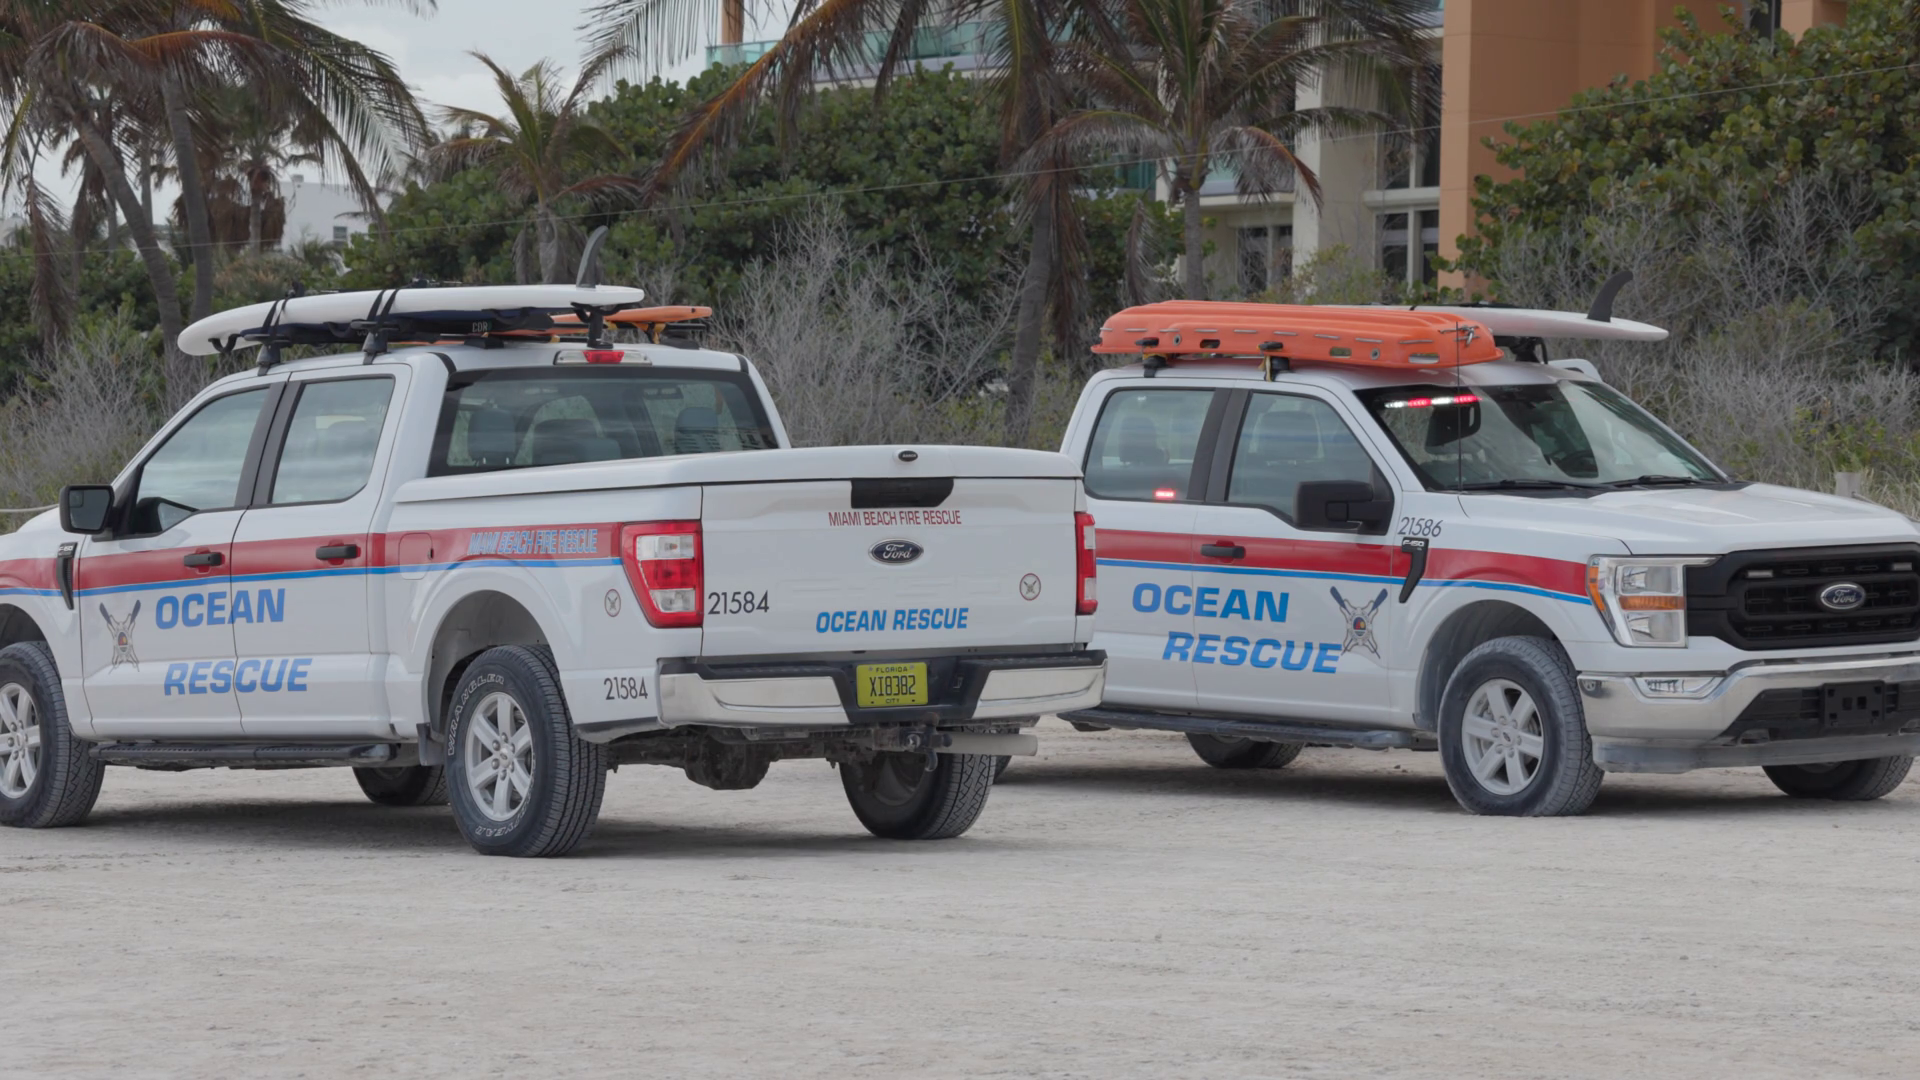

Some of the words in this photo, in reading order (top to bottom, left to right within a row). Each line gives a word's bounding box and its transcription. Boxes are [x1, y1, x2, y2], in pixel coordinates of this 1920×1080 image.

[828, 512, 861, 526] MIAMI
[863, 511, 897, 526] BEACH
[899, 511, 921, 525] FIRE
[923, 510, 962, 525] RESCUE
[1397, 516, 1444, 537] 21586
[497, 530, 534, 554] BEACH
[533, 529, 558, 554] FIRE
[559, 528, 598, 554] RESCUE
[155, 588, 286, 630] OCEAN
[708, 590, 769, 614] 21584
[1132, 583, 1289, 623] OCEAN
[816, 610, 887, 633] OCEAN
[893, 608, 969, 631] RESCUE
[1162, 631, 1342, 674] RESCUE
[164, 658, 313, 696] RESCUE
[604, 677, 648, 700] 21584
[869, 675, 916, 697] XI8382
[447, 673, 504, 756] WRANGLER
